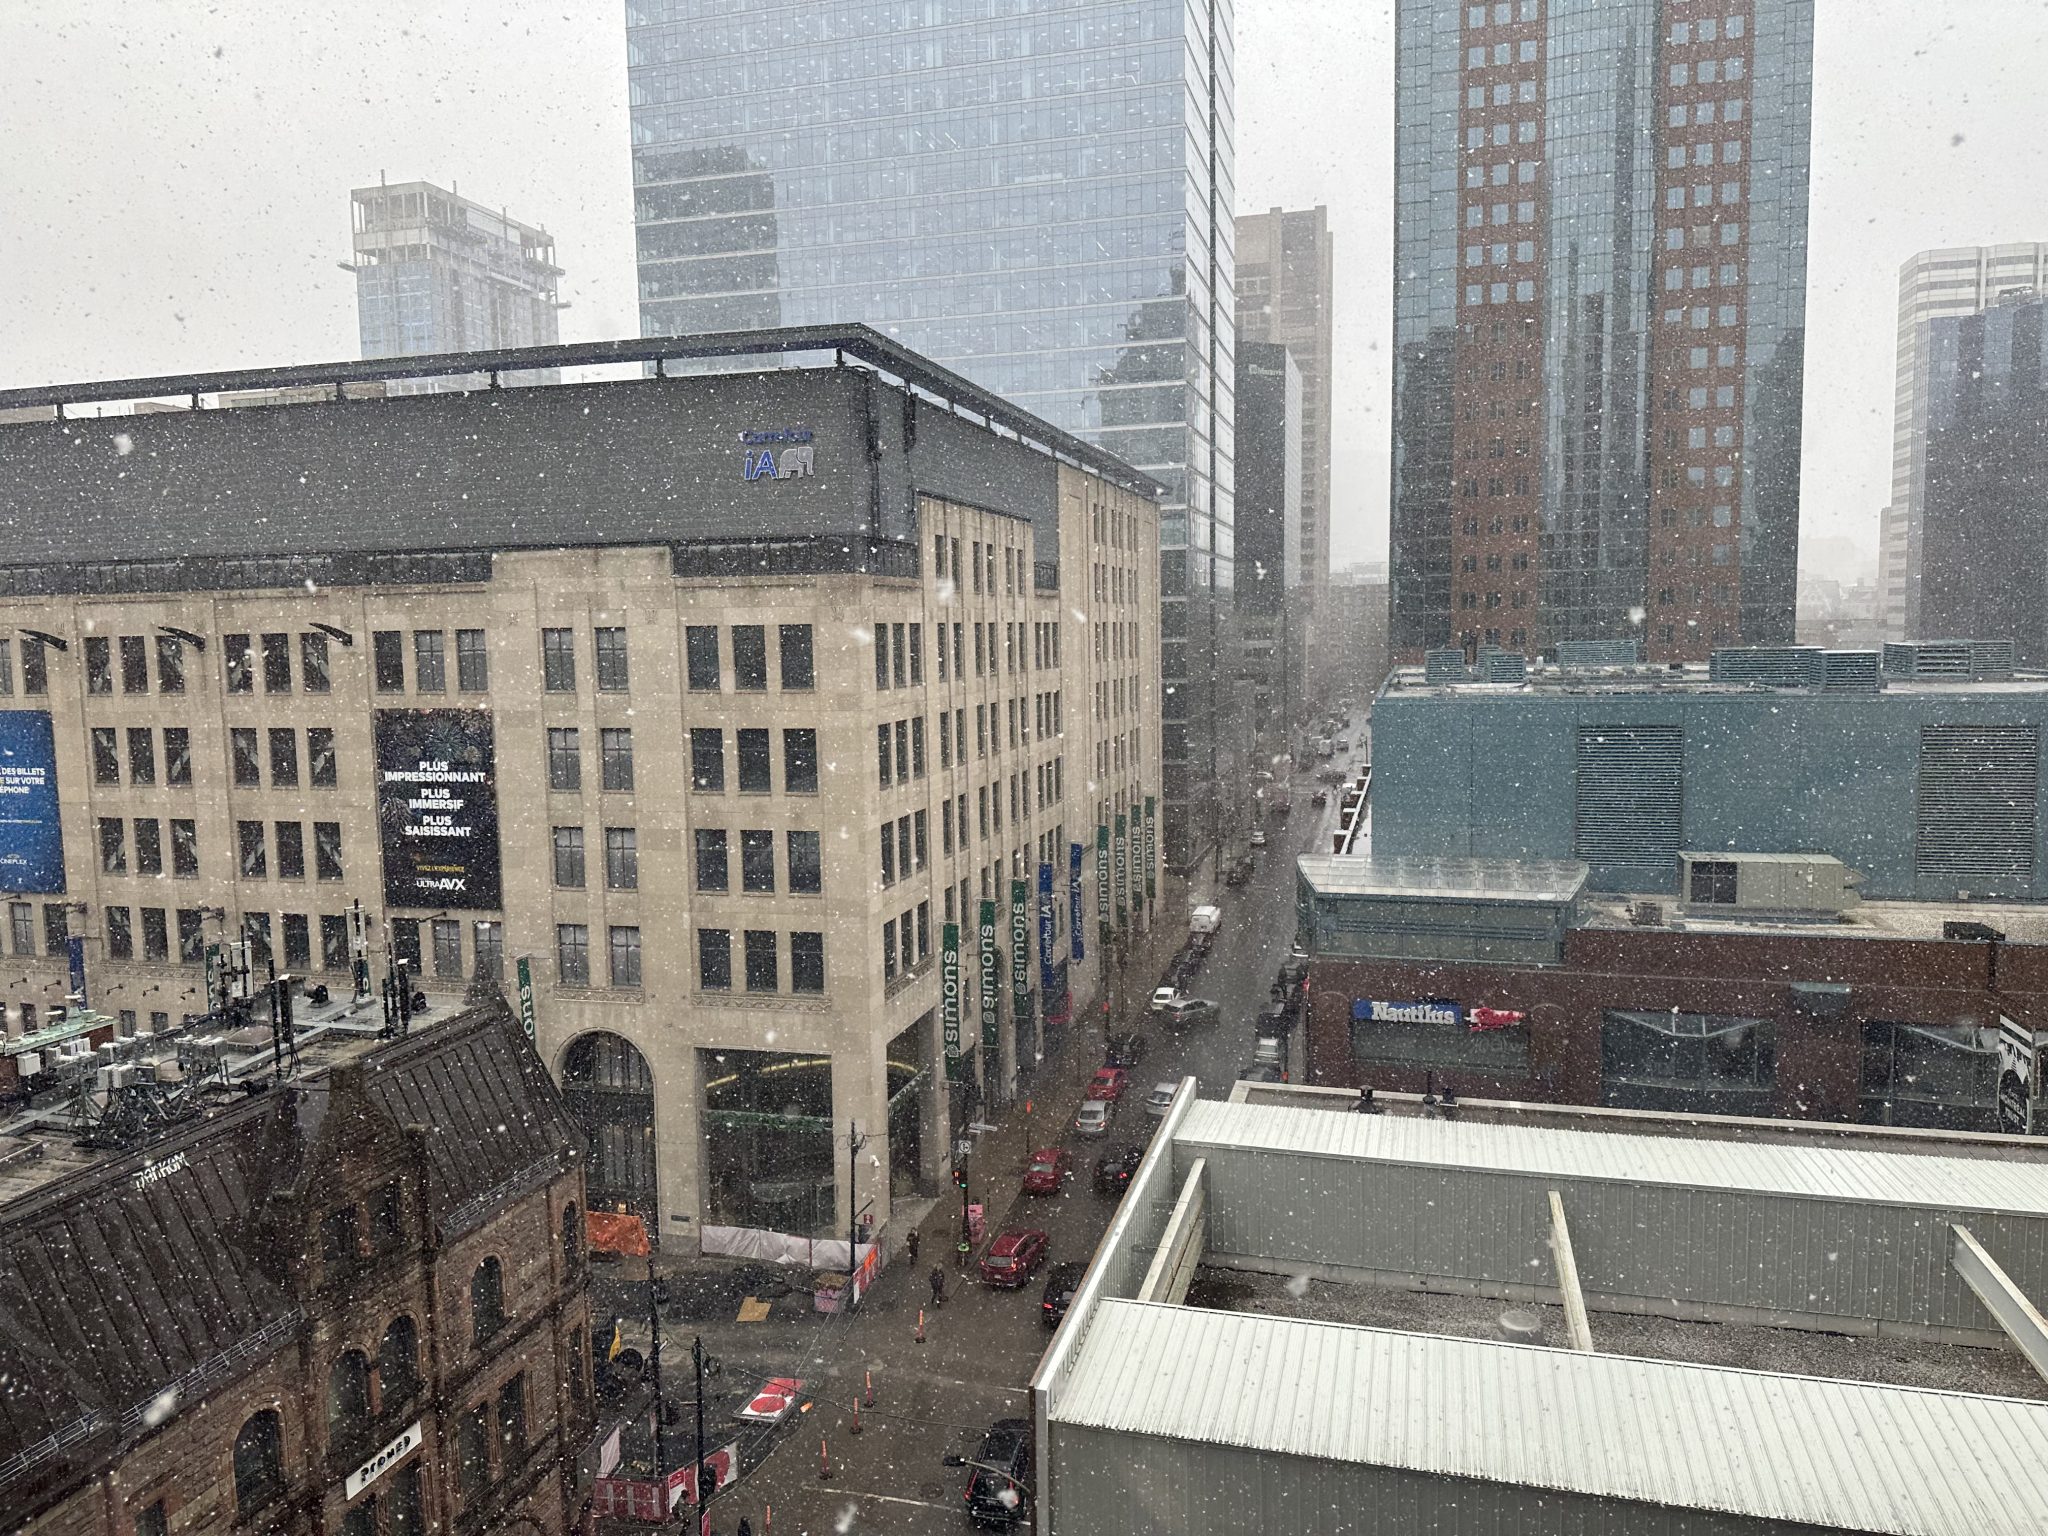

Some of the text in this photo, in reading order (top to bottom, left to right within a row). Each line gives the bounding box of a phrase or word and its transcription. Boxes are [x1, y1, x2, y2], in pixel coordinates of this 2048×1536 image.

[1, 768, 45, 776] DES BILLETS
[419, 761, 449, 772] PLUS
[5, 777, 21, 785] SUR
[21, 777, 45, 785] VOTRE
[385, 771, 486, 782] IMPRESSIONNANT
[421, 788, 451, 799] PLUS
[408, 799, 464, 810] IMMERSIF
[422, 815, 452, 826] PLUS
[404, 825, 472, 837] SAISISSANT
[1098, 849, 1108, 912] simons
[1013, 901, 1026, 981] simons
[981, 925, 995, 1009] simons
[944, 951, 958, 1042] simons
[521, 985, 534, 1040] ons
[1371, 1001, 1455, 1024] Nautilus
